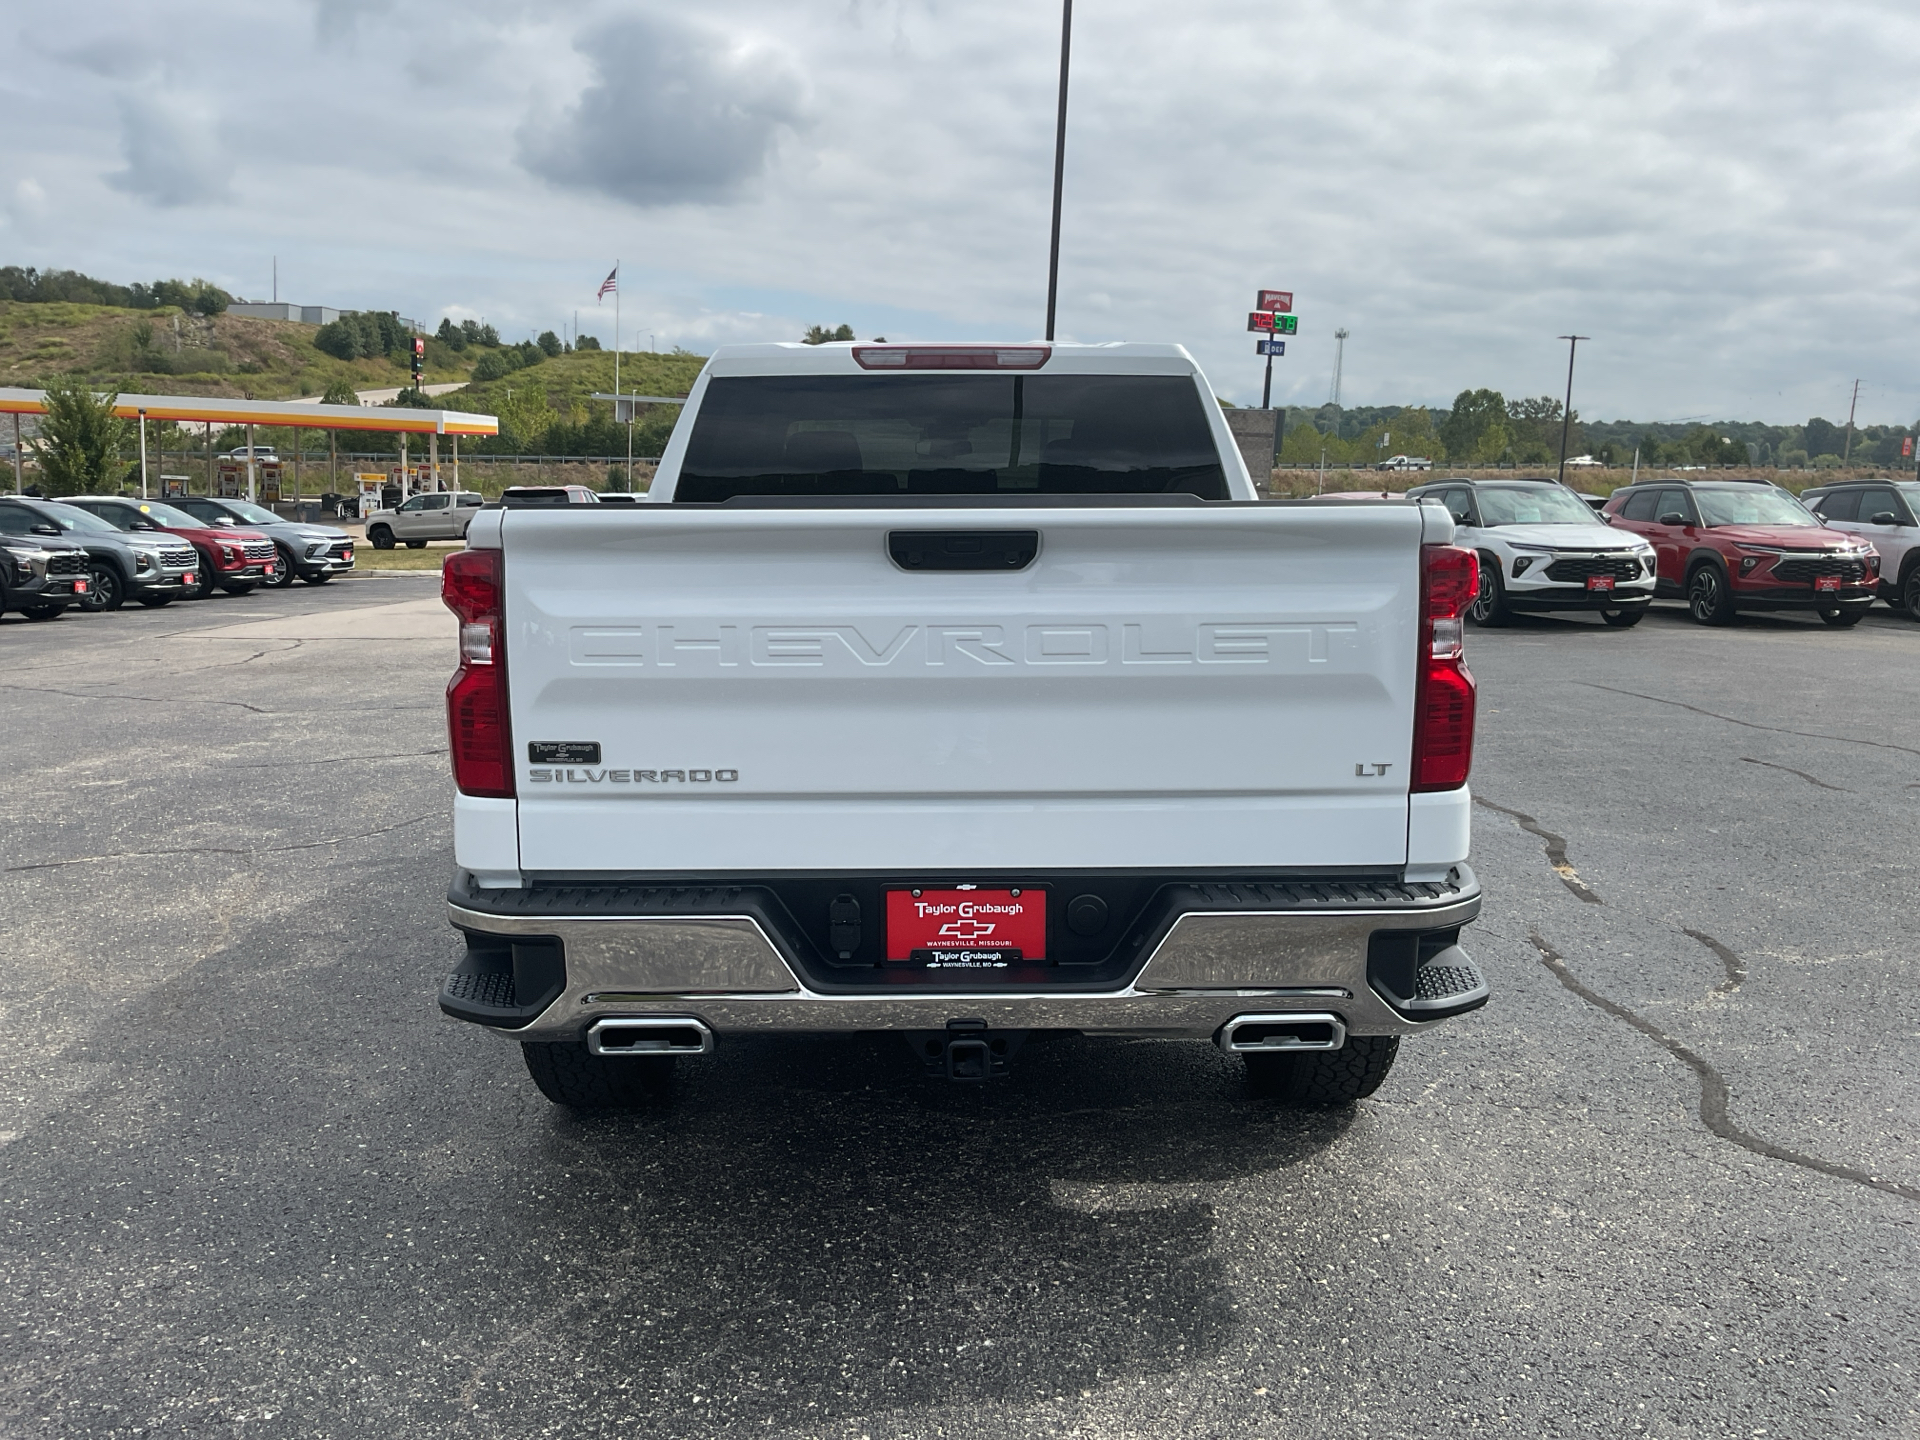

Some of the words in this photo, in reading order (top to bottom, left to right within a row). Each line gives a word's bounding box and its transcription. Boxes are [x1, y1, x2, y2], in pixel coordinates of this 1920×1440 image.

[569, 621, 1358, 667] CHEVROLET
[533, 743, 557, 753] Taylor
[558, 743, 593, 753] Grubaugh
[530, 769, 739, 782] SILVERADO
[1355, 762, 1393, 776] LT
[914, 902, 957, 918] Taylor
[958, 902, 1023, 918] Grubaugh
[932, 951, 960, 963] Taylor
[960, 951, 1002, 962] Grubaugh
